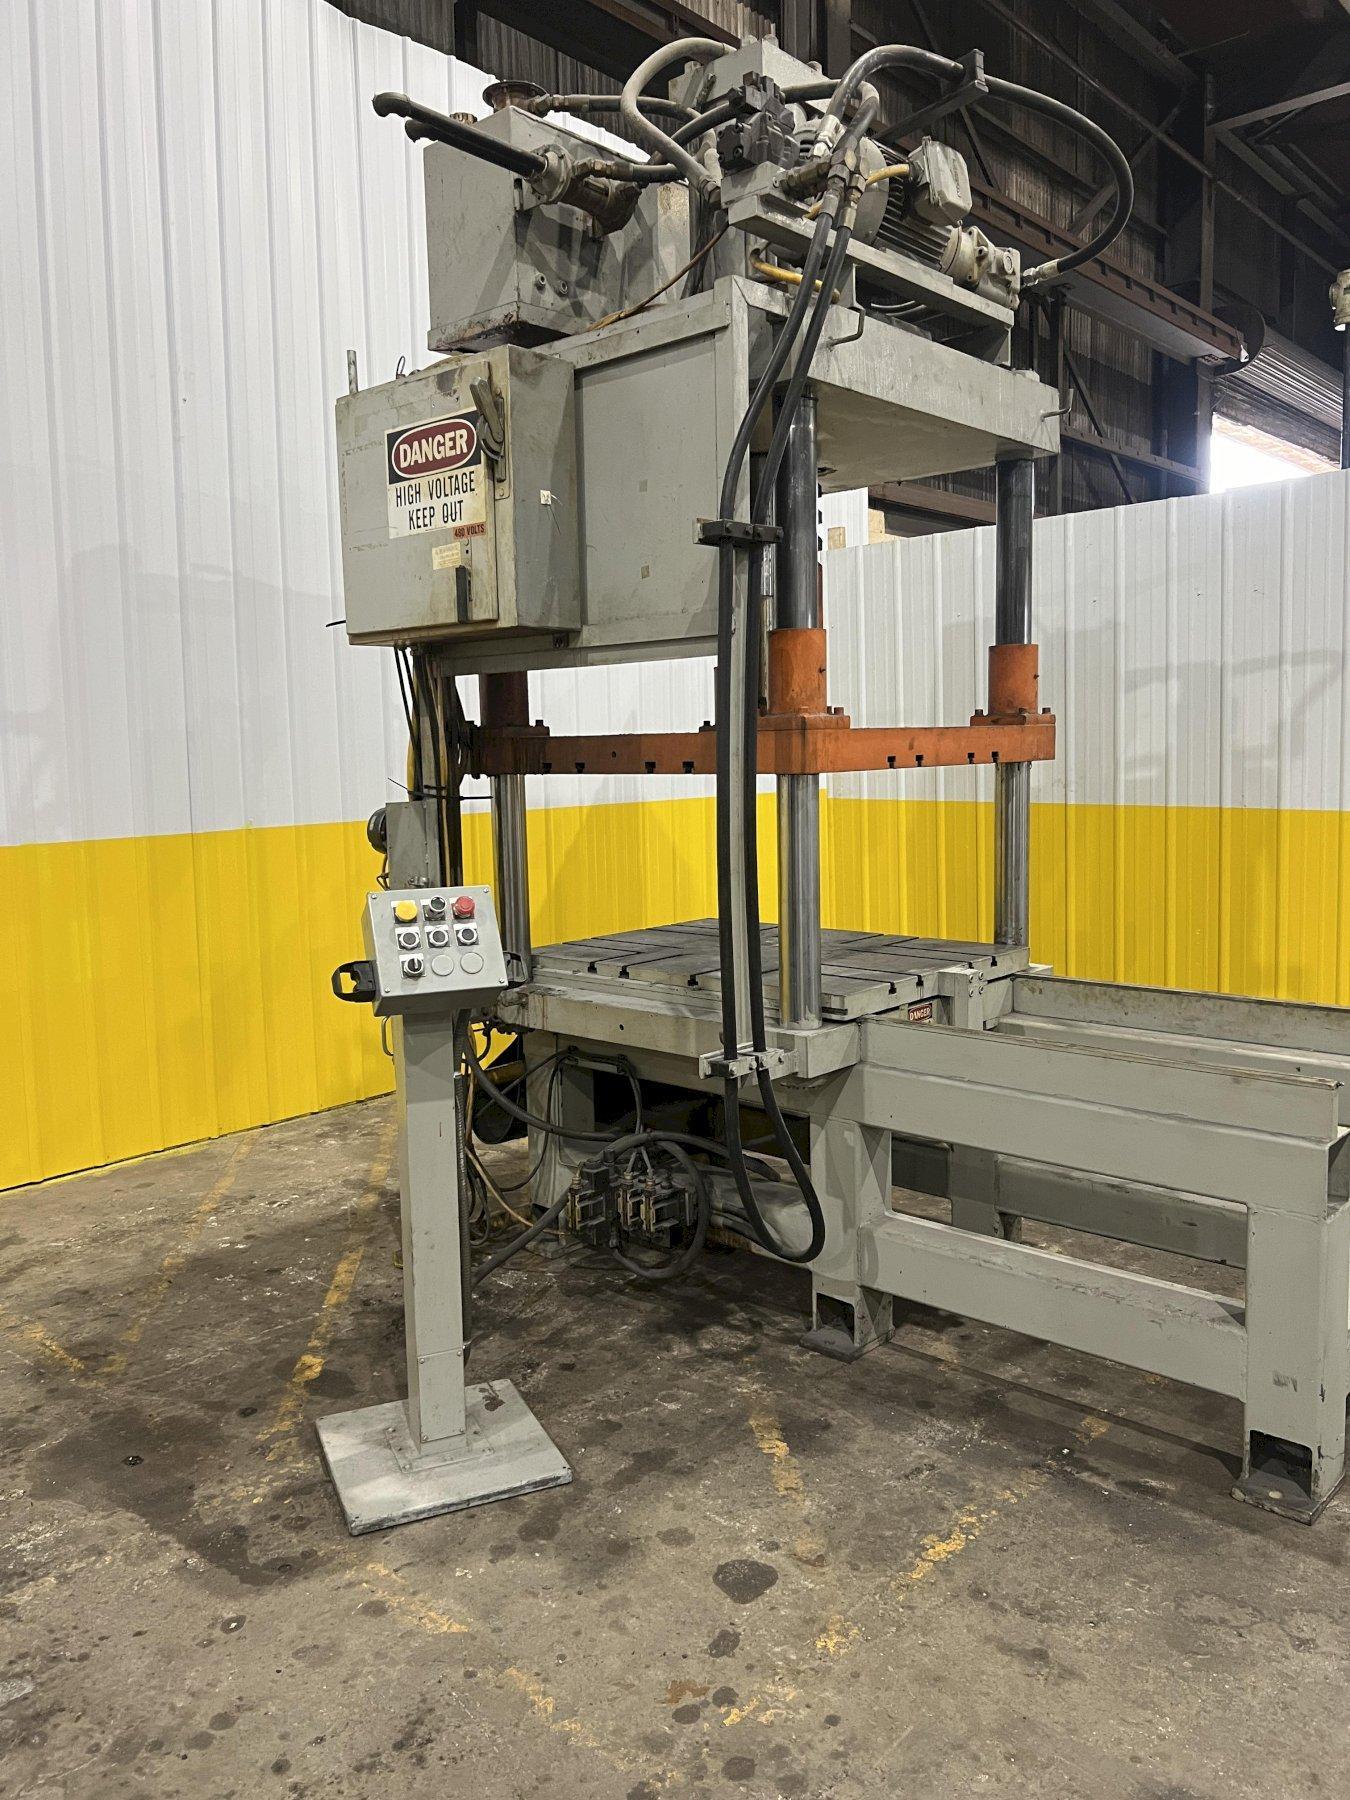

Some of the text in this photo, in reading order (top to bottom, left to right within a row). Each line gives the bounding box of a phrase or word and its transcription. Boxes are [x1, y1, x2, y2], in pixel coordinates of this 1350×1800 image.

[400, 428, 468, 469] DANGER
[395, 470, 475, 507] HIGH VOLTAGE
[408, 500, 464, 530] KEEP OUT
[466, 523, 485, 536] VOLTS
[909, 1007, 931, 1021] DANGER
